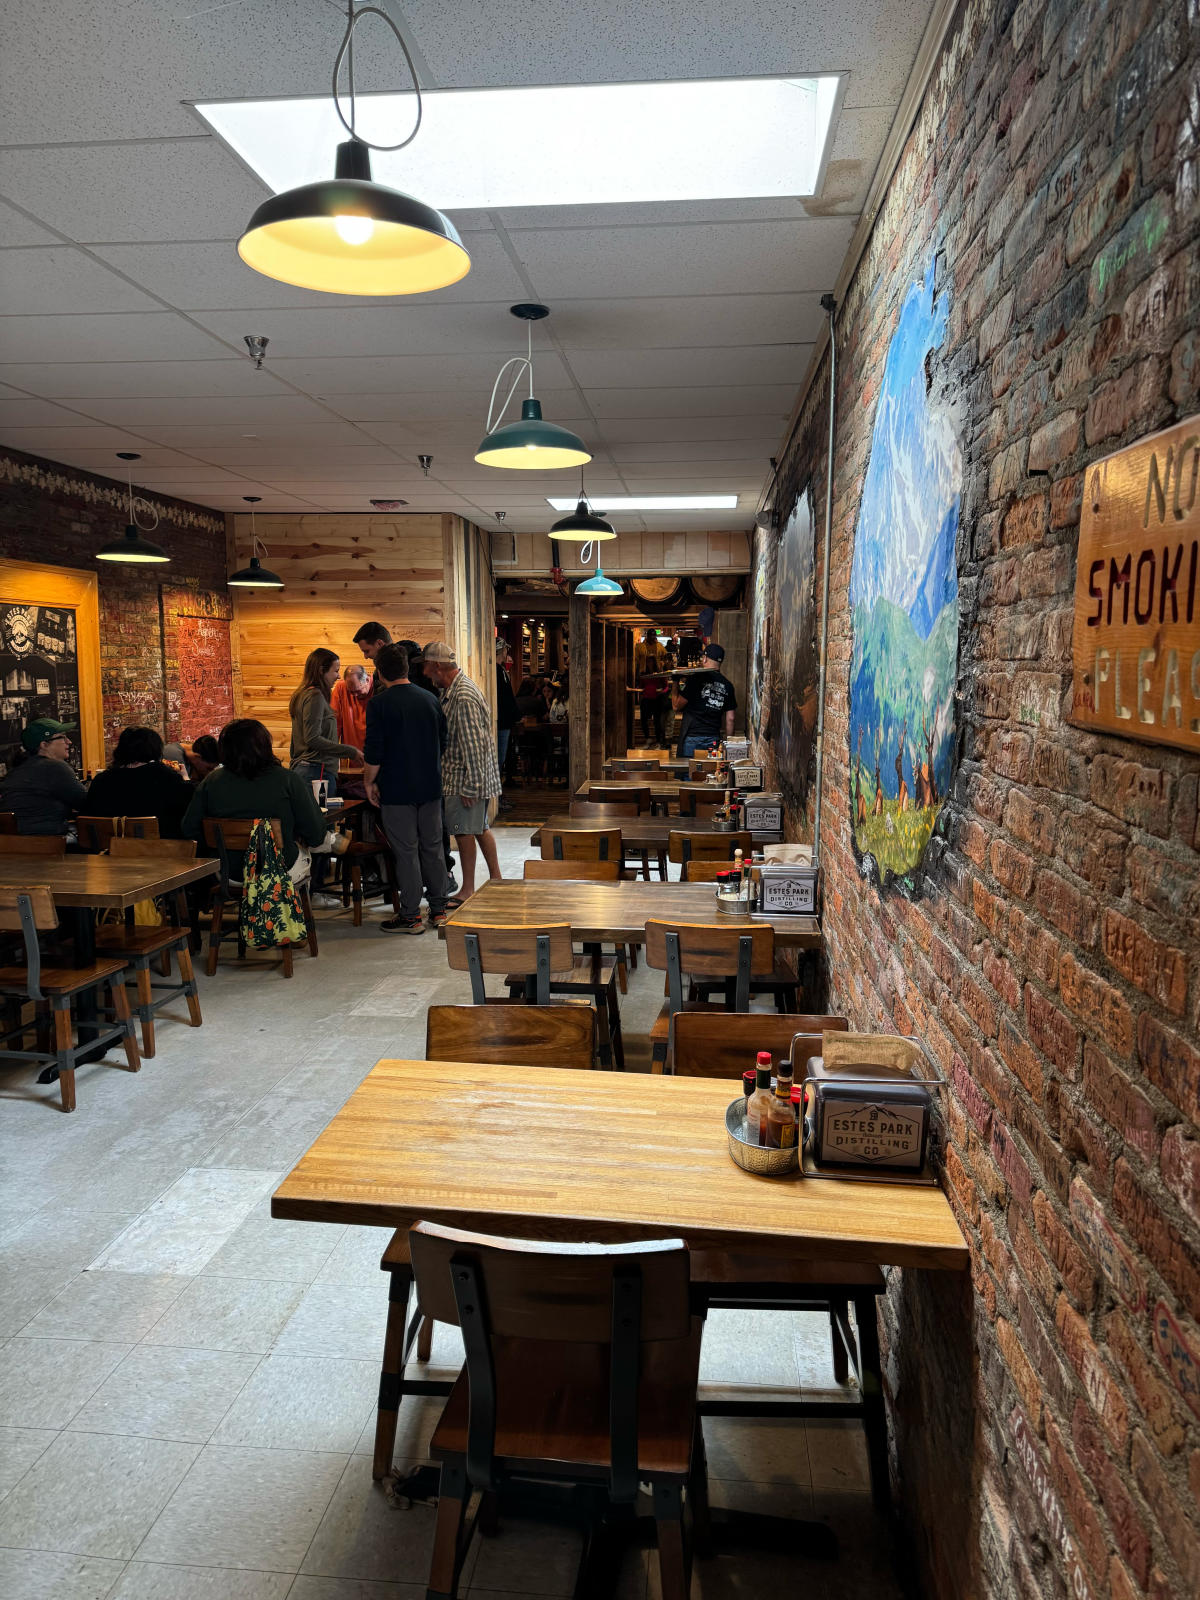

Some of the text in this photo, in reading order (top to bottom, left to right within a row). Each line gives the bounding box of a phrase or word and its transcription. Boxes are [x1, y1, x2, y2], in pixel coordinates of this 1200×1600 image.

[1143, 435, 1200, 529] NO
[1087, 540, 1199, 627] SMOKI
[833, 1120, 875, 1133] ESTES
[880, 1122, 913, 1135] PARK
[836, 1136, 909, 1150] DISTILLING
